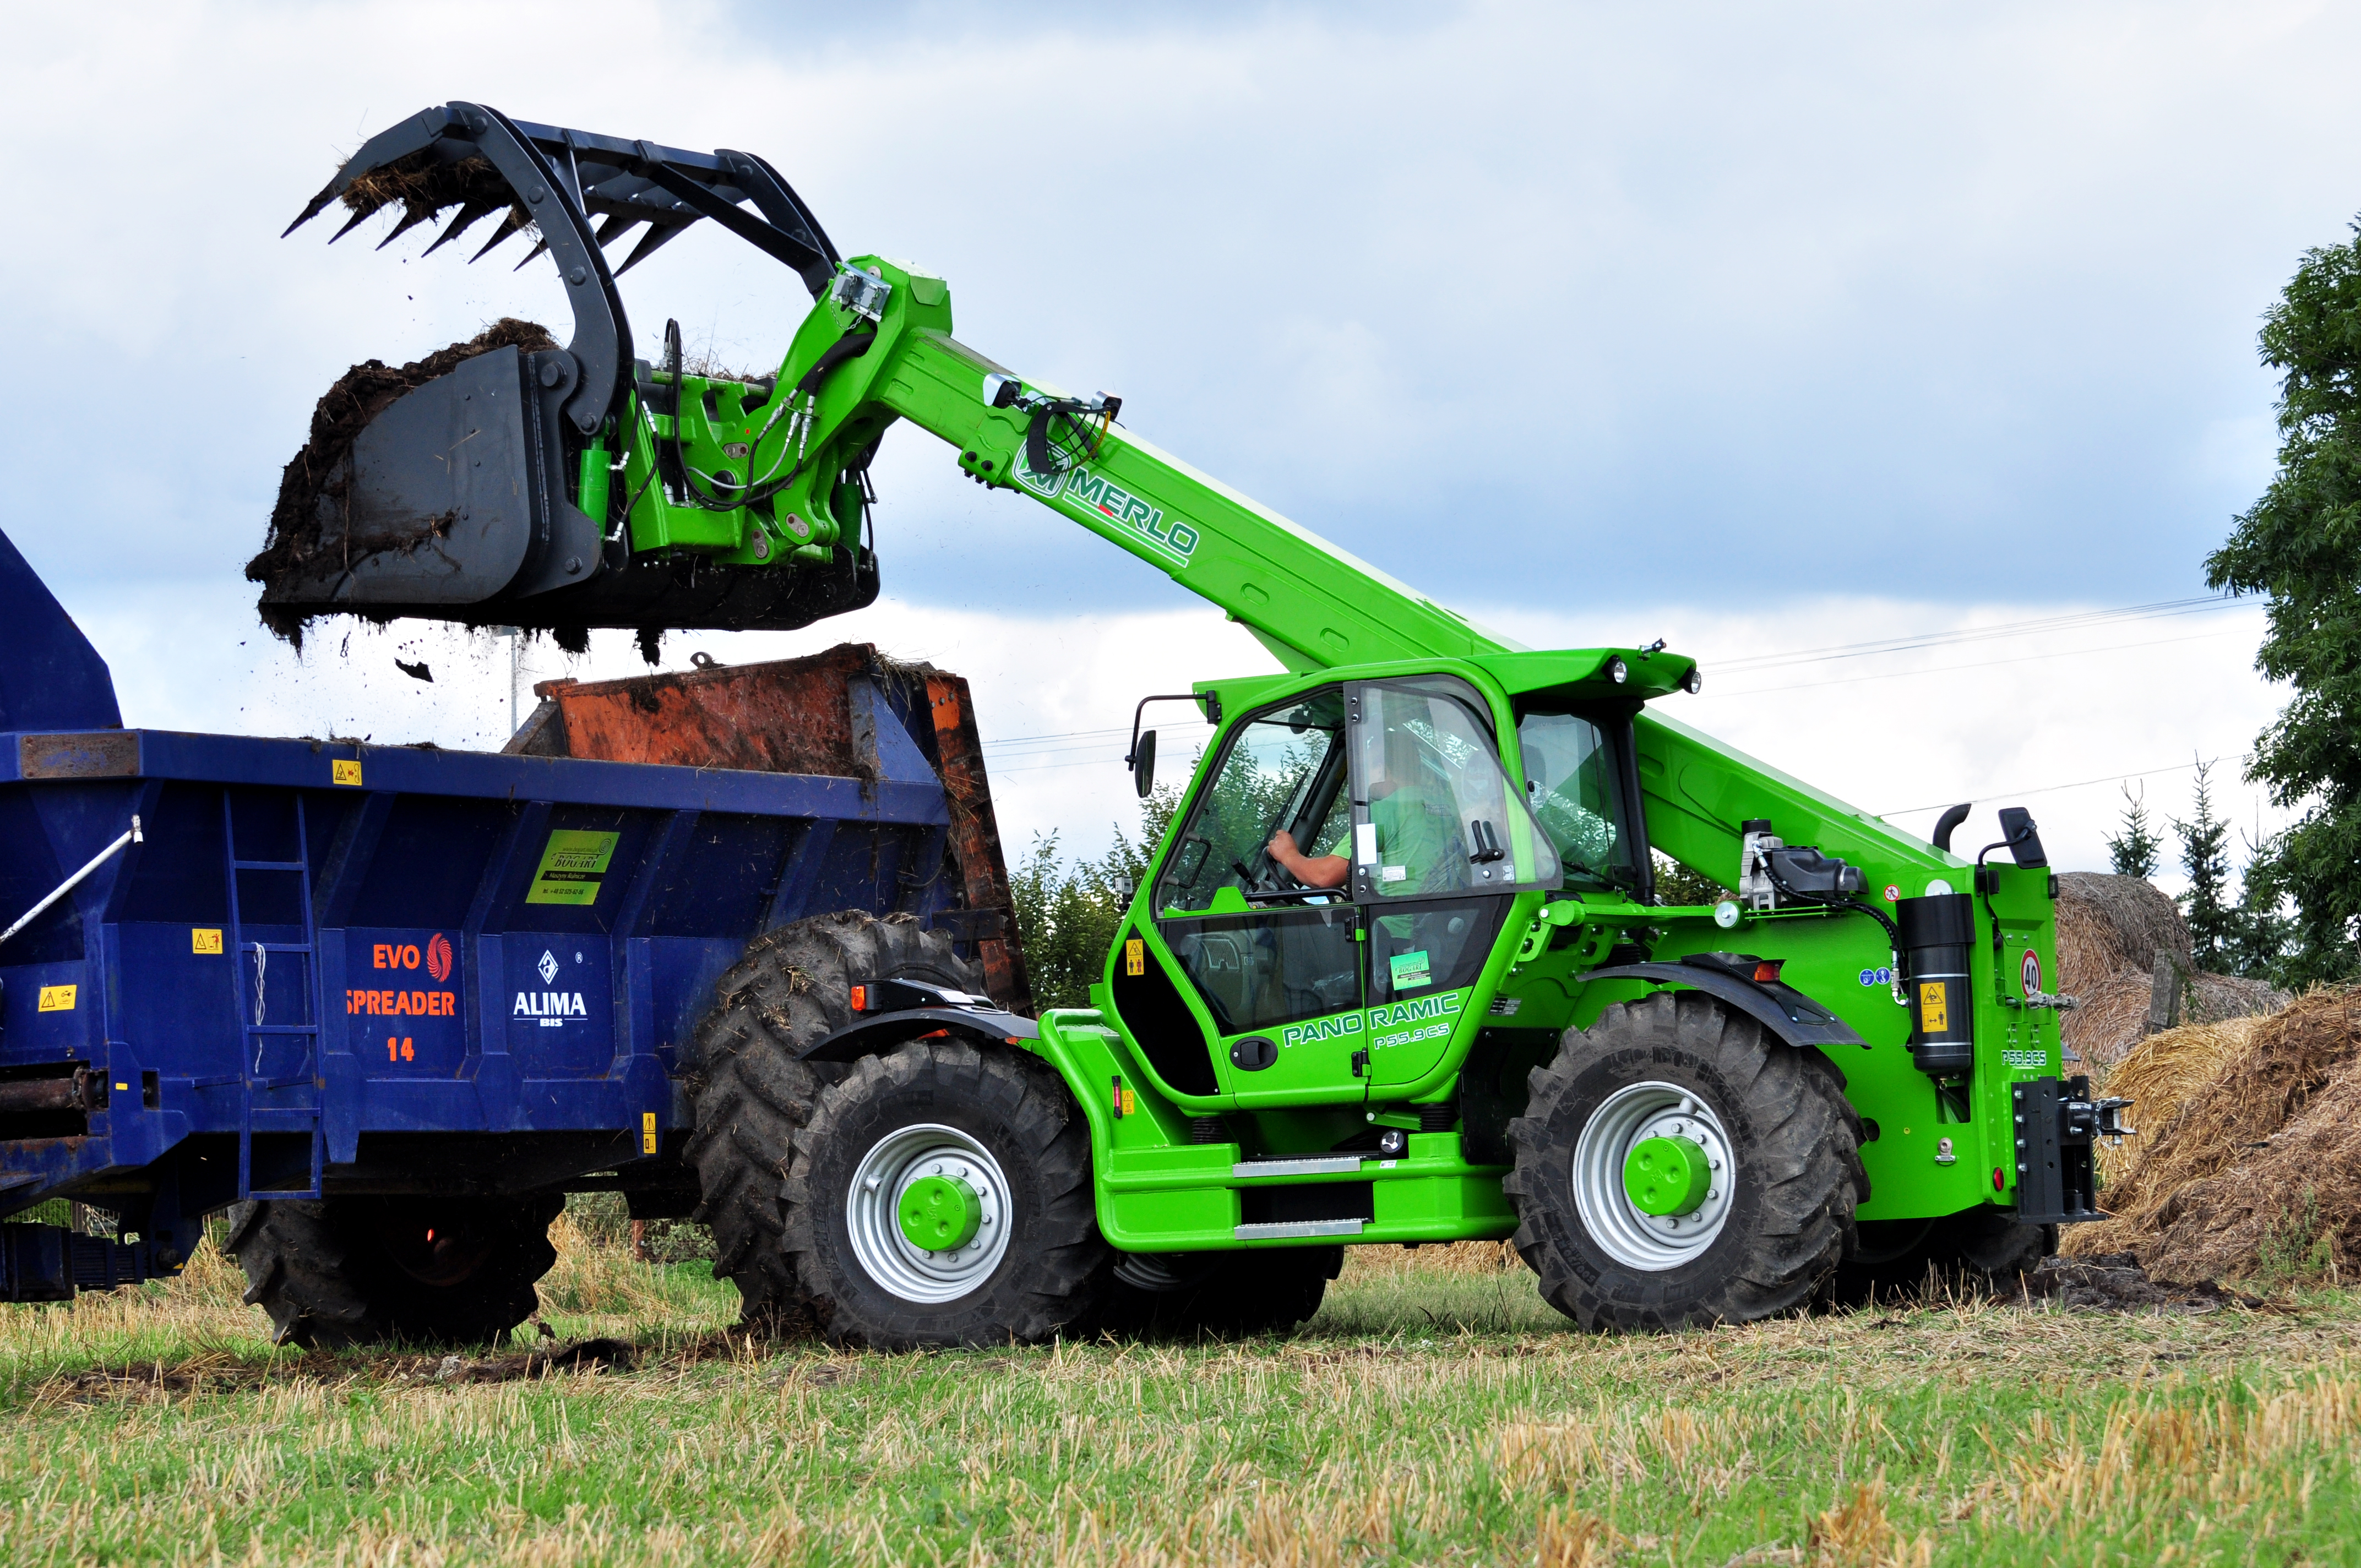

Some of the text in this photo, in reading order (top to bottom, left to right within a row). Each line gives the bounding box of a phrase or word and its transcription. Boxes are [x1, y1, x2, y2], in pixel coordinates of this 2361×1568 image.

[1067, 467, 1200, 556] MERLO
[373, 944, 421, 970] EVO
[2025, 963, 2037, 990] 40
[513, 992, 587, 1015] ALIMA
[540, 1018, 563, 1027] BIS
[1373, 1022, 1450, 1050] P55.9CS
[387, 1037, 415, 1061] 14
[2001, 1049, 2047, 1066] P55.9CS
